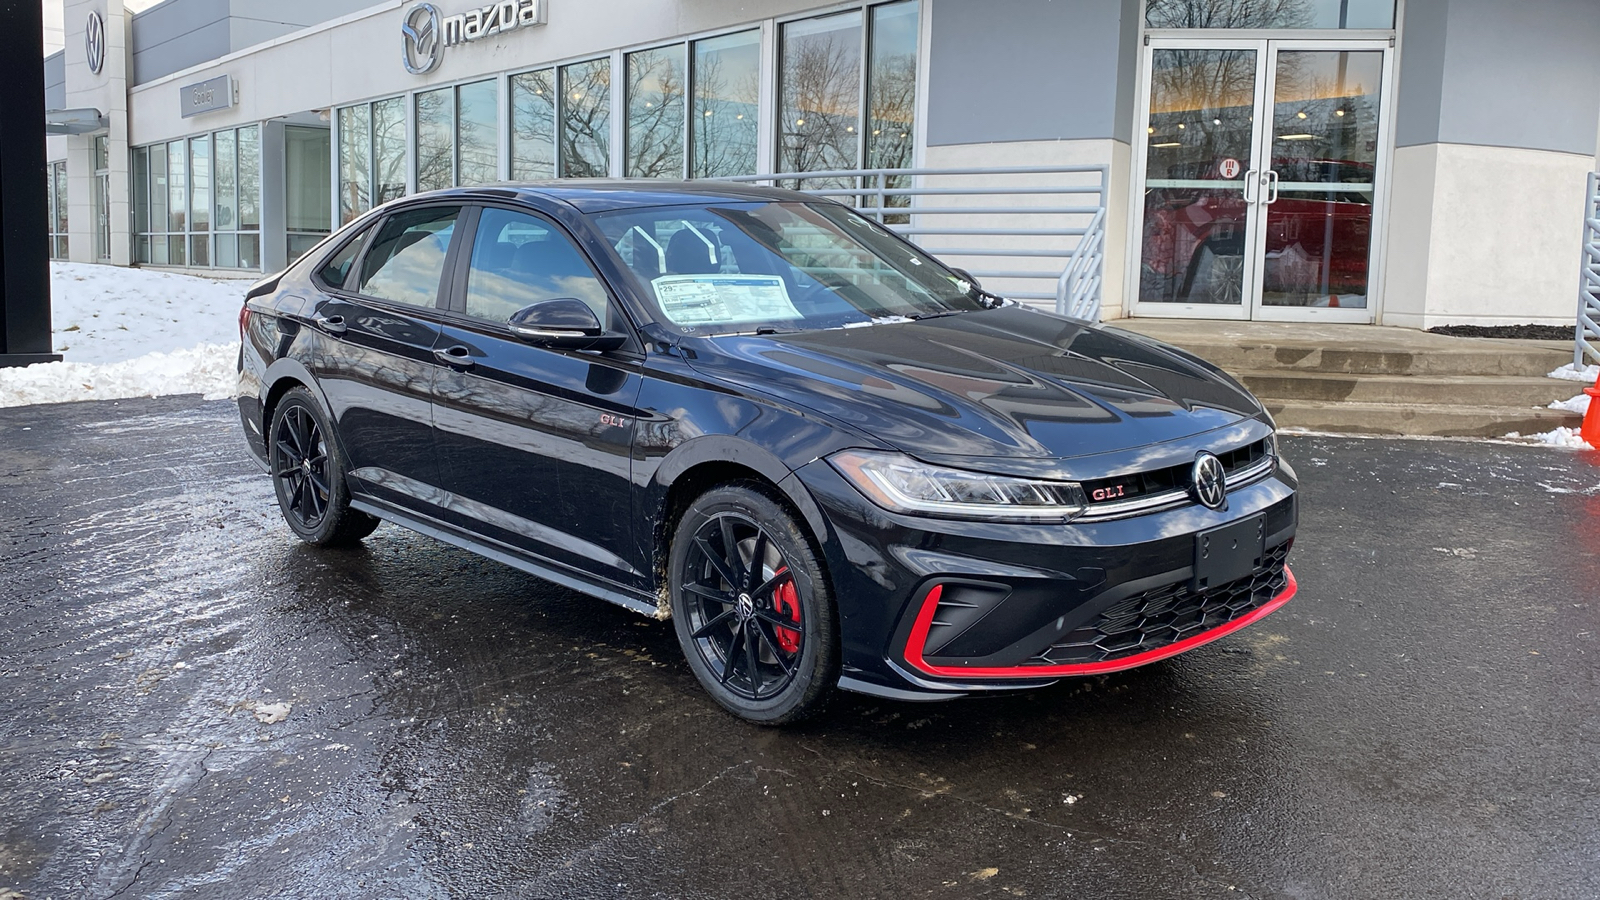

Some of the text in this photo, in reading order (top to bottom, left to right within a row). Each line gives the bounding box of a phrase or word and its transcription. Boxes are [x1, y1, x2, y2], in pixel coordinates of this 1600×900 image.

[442, 0, 547, 47] mazda
[600, 413, 625, 428] GLI
[1092, 484, 1125, 501] GLI
